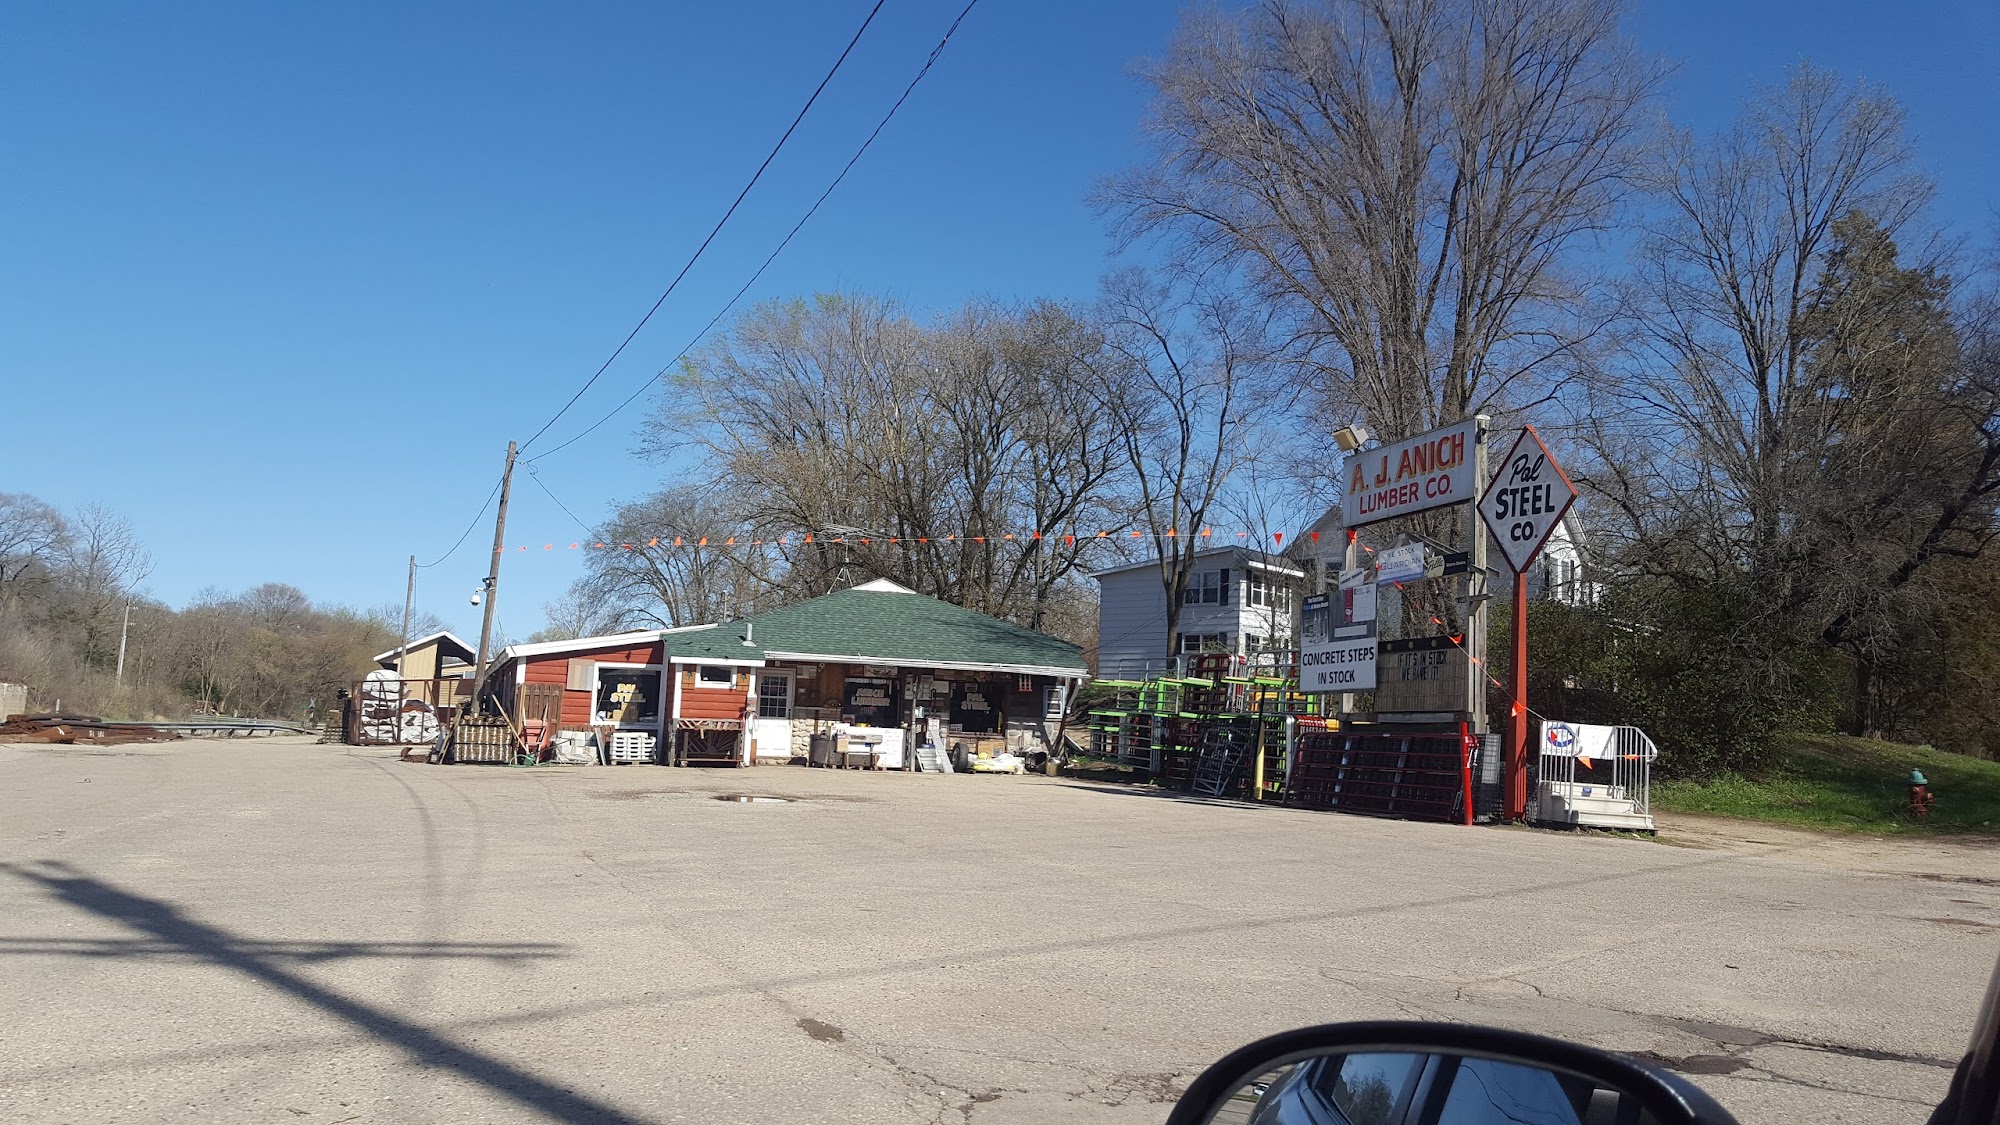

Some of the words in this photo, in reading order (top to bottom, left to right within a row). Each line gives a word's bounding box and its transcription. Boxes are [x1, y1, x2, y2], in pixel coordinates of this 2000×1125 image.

[1349, 463, 1369, 496] A.
[1374, 455, 1391, 488] J.
[1395, 431, 1465, 482] ANICH
[1509, 453, 1545, 486] Pal
[1359, 482, 1419, 514] LUMBER
[1425, 474, 1453, 499] CO.
[1495, 483, 1555, 520] STEEL
[1510, 521, 1538, 542] CO.
[1397, 547, 1415, 557] STOCK
[1381, 557, 1421, 571] GUARDIAN
[1302, 650, 1346, 667] CONCRETE
[1348, 646, 1375, 662] STEPS
[1318, 672, 1327, 685] IN
[1328, 669, 1356, 684] STOCK
